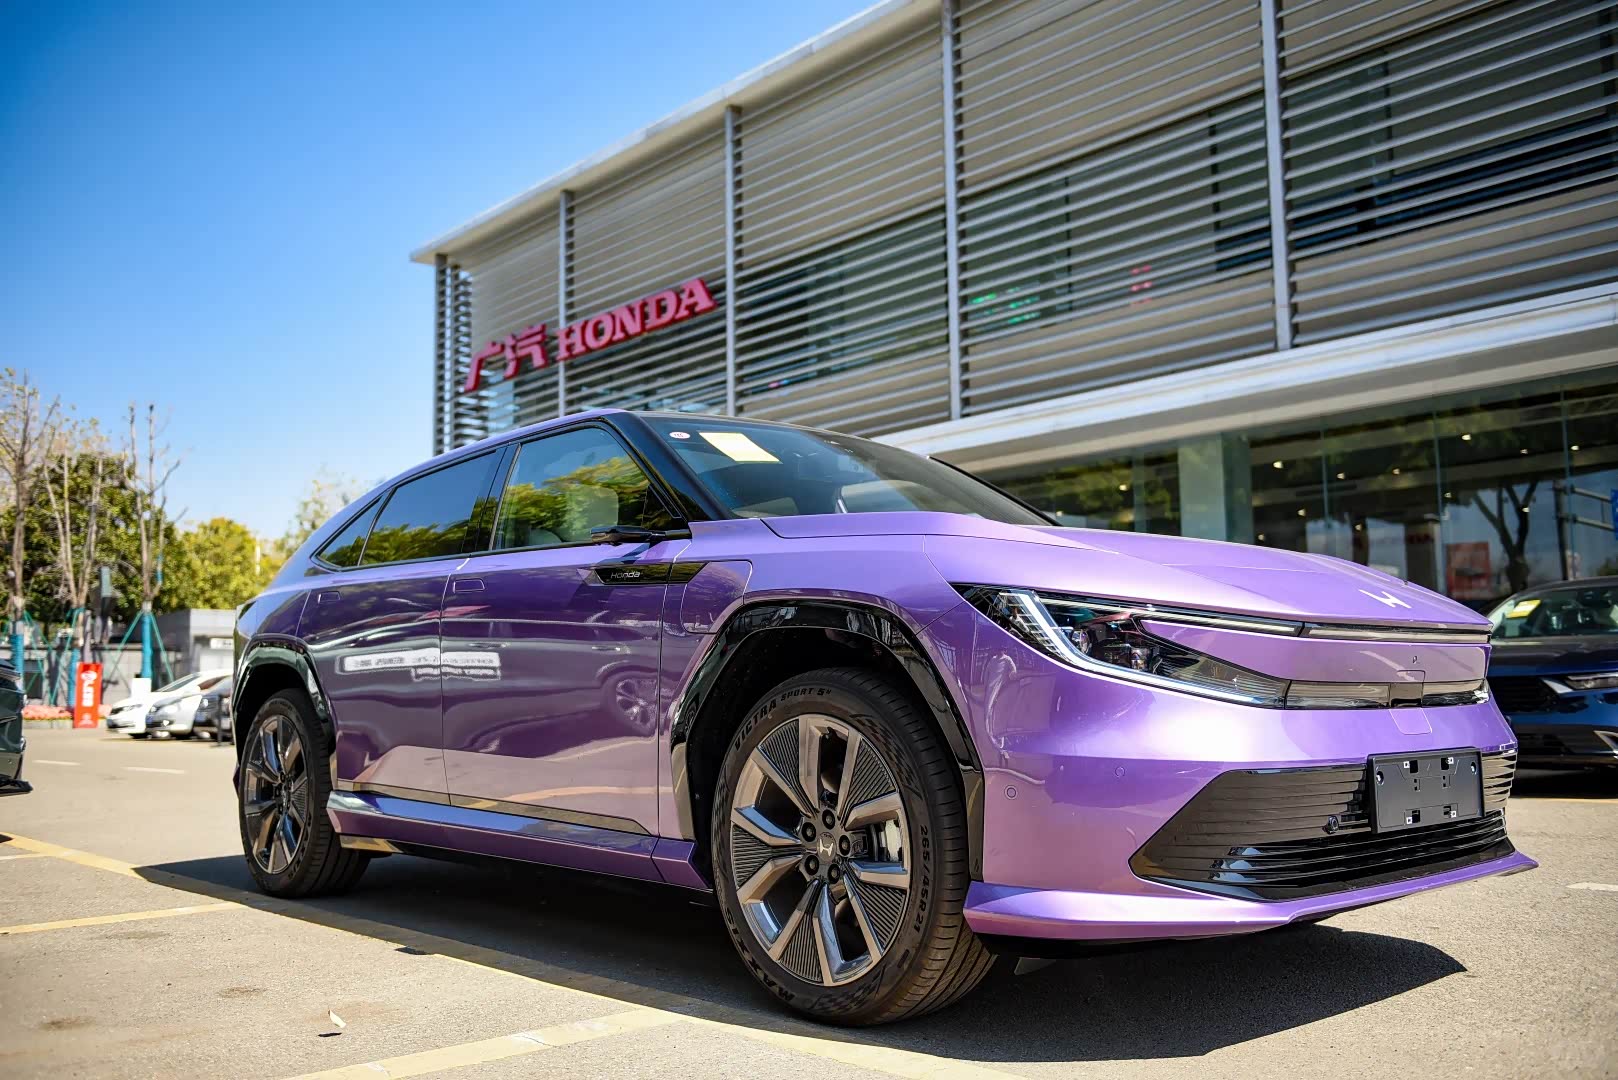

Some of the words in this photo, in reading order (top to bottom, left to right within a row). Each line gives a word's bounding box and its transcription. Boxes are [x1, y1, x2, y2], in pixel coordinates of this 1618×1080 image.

[464, 323, 549, 393] 广汽
[555, 277, 718, 362] HONDA
[610, 571, 641, 579] Honda
[734, 698, 777, 751] VICTRA
[780, 687, 815, 702] SPORT
[913, 824, 931, 934] 265/45R21
[725, 906, 797, 1002] MAXXIS
